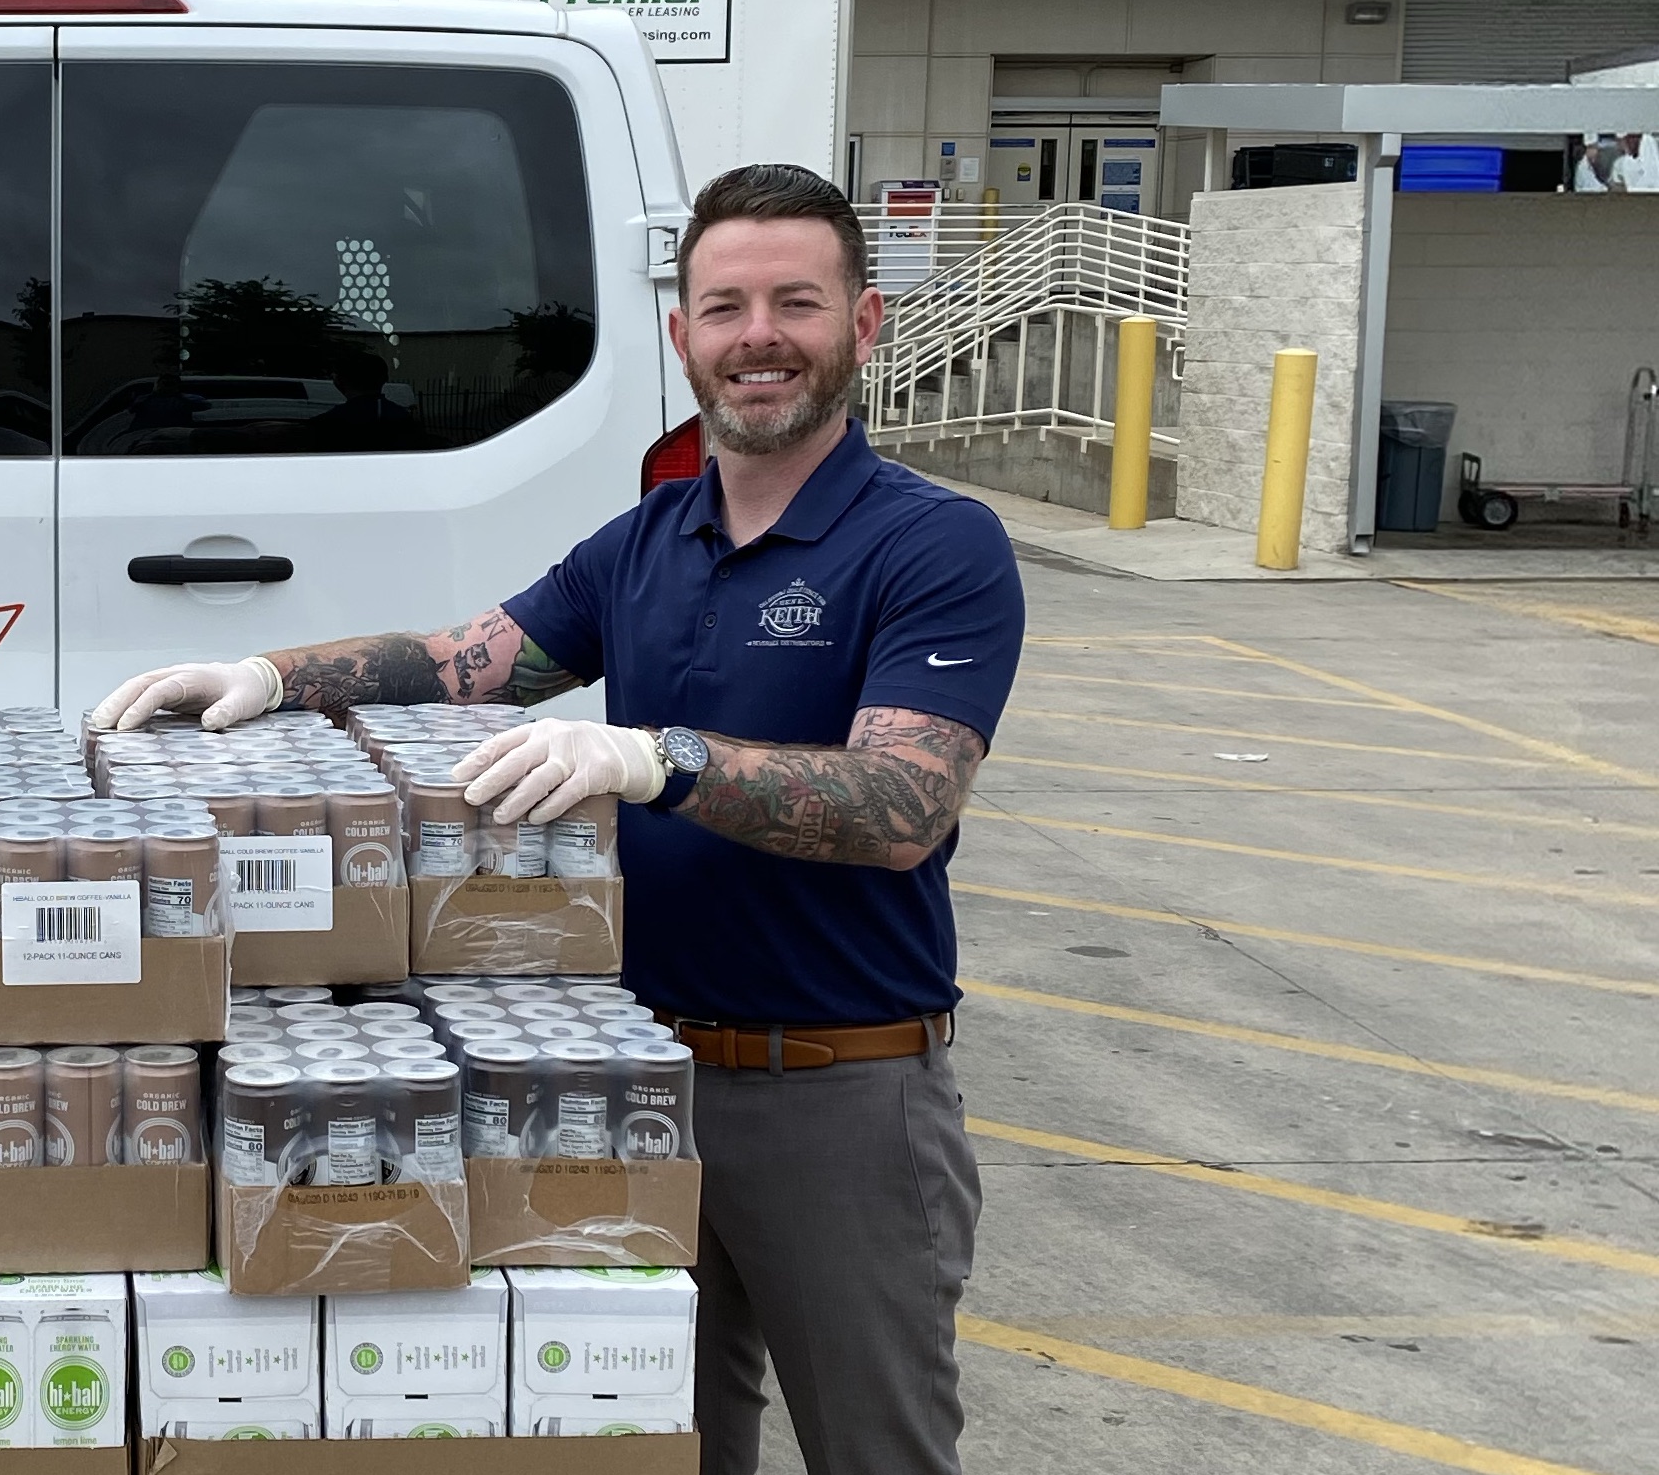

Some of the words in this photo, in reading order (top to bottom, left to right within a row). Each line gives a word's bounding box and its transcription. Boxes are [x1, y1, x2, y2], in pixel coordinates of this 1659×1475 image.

[648, 7, 700, 17] LEASING
[758, 606, 823, 627] KEITH
[345, 827, 366, 837] COLD
[370, 826, 390, 836] BREW
[177, 896, 192, 904] 70
[22, 952, 55, 961] 12-PACK
[57, 952, 97, 960] 11-OUNCE
[99, 951, 121, 959] CANS
[625, 1091, 648, 1104] COLD
[650, 1093, 676, 1106] BREW
[12, 1100, 36, 1113] BREW
